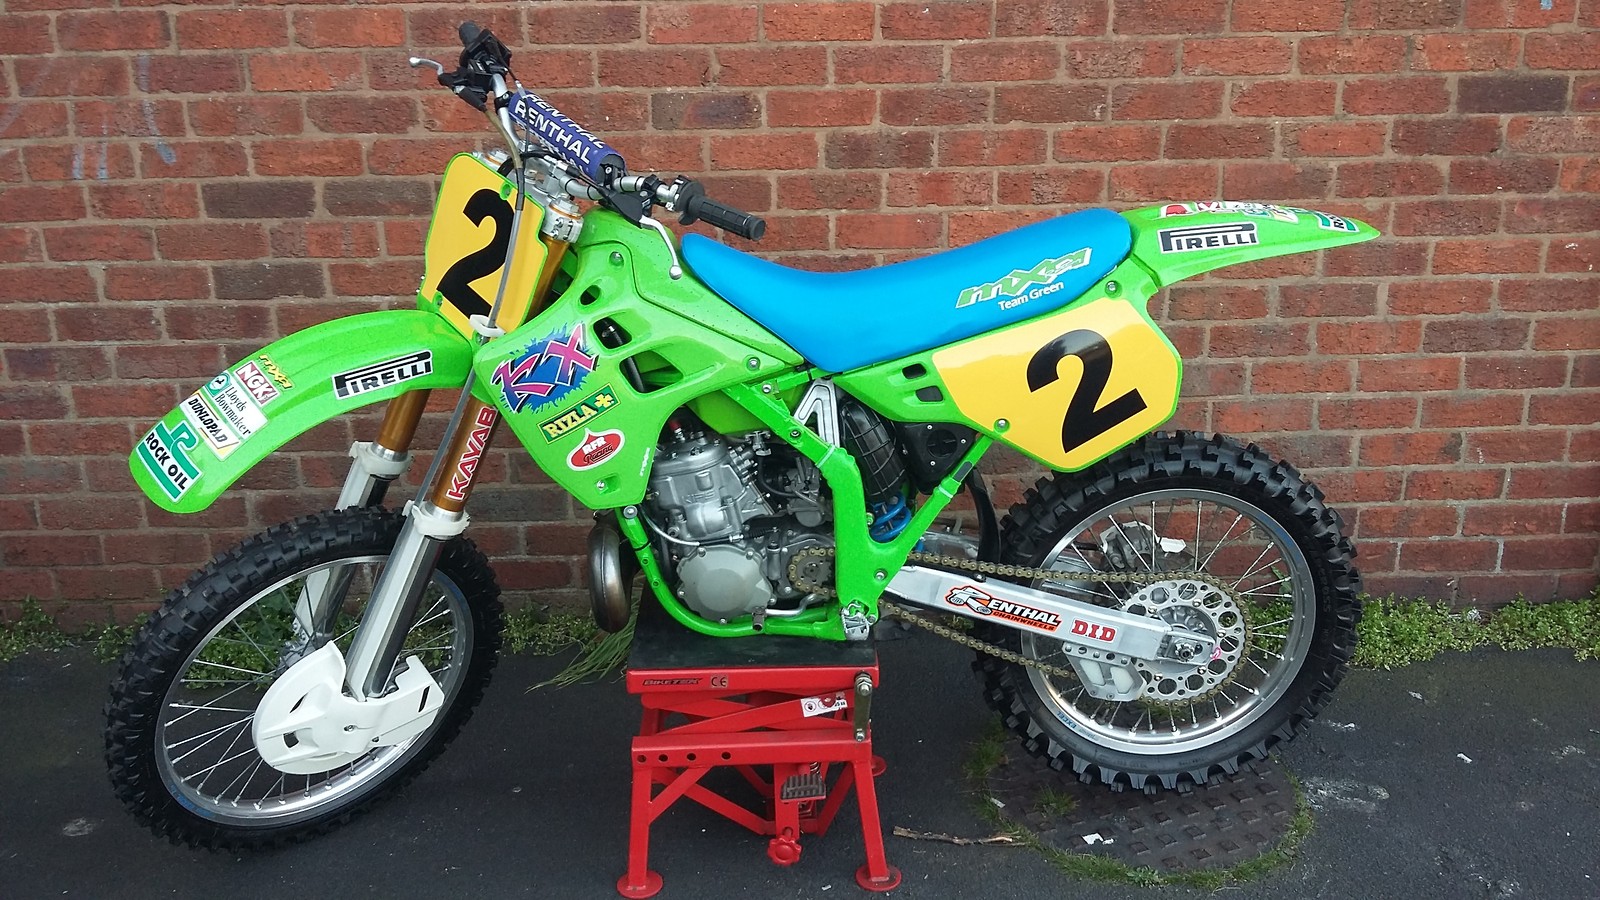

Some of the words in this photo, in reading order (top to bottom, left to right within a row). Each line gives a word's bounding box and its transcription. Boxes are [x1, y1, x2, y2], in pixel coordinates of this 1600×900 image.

[514, 99, 590, 164] RENTHAL
[436, 188, 515, 319] 2
[1159, 222, 1257, 252] PIRELLI
[998, 295, 1029, 311] Team
[1029, 282, 1064, 300] Green
[235, 363, 276, 401] NGK
[334, 351, 432, 398] PIRELLI
[490, 323, 599, 413] KX
[225, 386, 247, 412] Lloyds
[1026, 329, 1148, 454] 2
[188, 398, 228, 443] DUNLOPAD
[214, 393, 252, 436] Bowmaker
[145, 432, 171, 466] ROCK
[167, 464, 190, 490] OIL
[582, 436, 607, 455] RFR
[993, 611, 1055, 631] CHAINWHEELS
[1057, 711, 1077, 729] EXCEL
